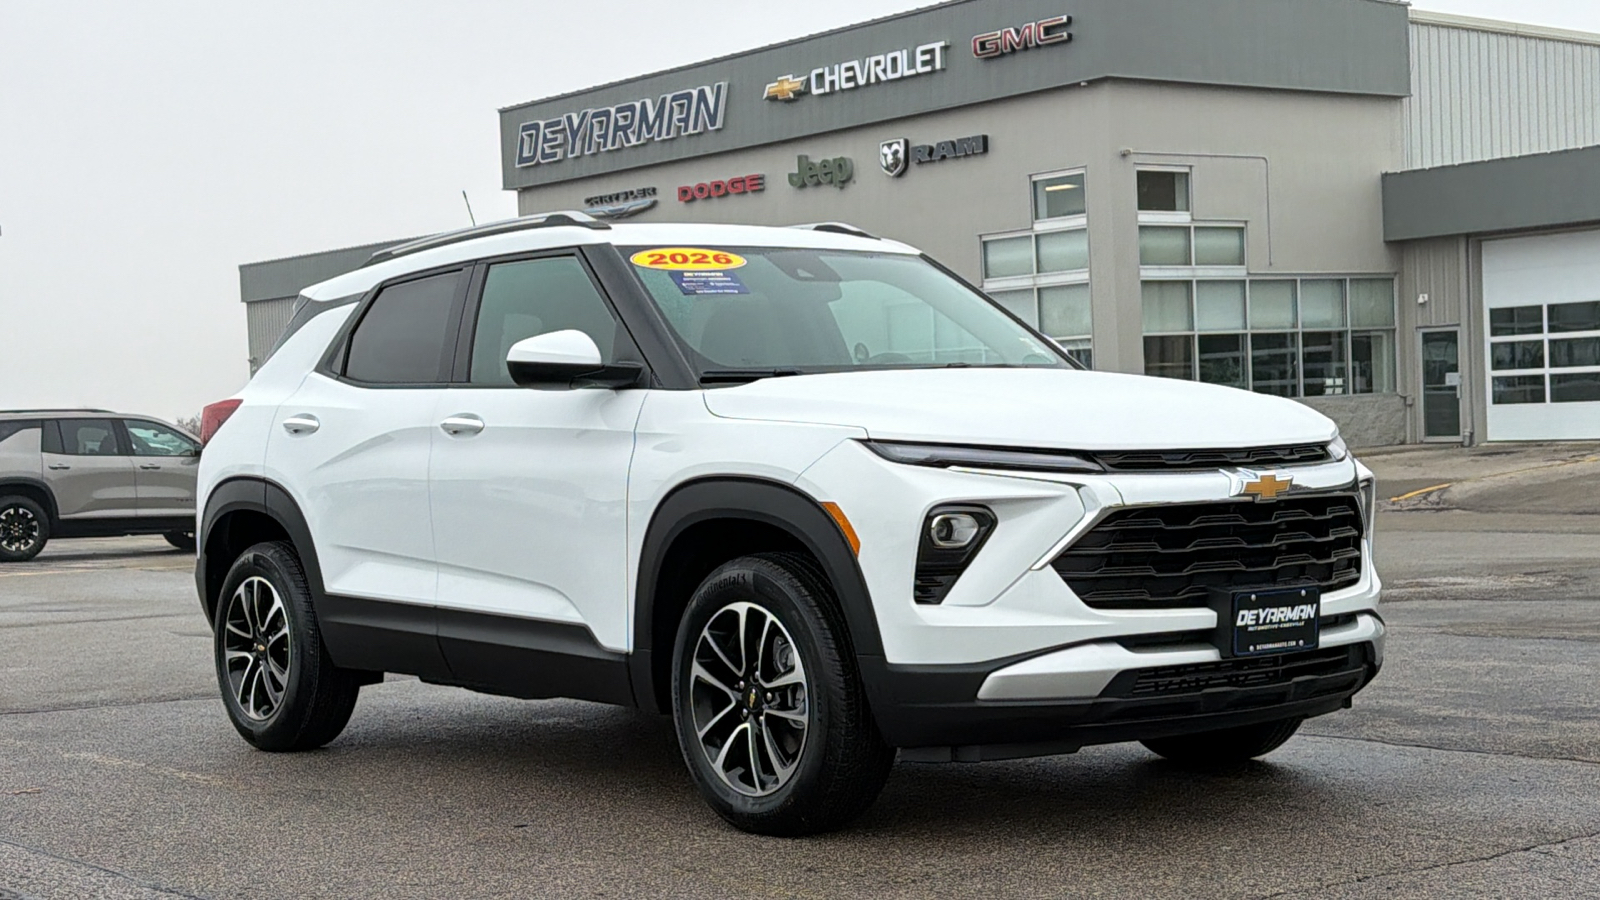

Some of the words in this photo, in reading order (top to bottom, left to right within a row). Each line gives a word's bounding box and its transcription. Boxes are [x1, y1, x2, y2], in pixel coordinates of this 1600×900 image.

[971, 15, 1073, 60] GMC
[810, 40, 947, 95] CHEVROLET
[515, 81, 729, 168] DEYARMAN
[911, 134, 989, 165] RAM
[788, 155, 854, 189] Jeep
[677, 173, 765, 204] DODGE
[647, 252, 733, 266] 2026
[1236, 604, 1317, 626] DEYARMAN
